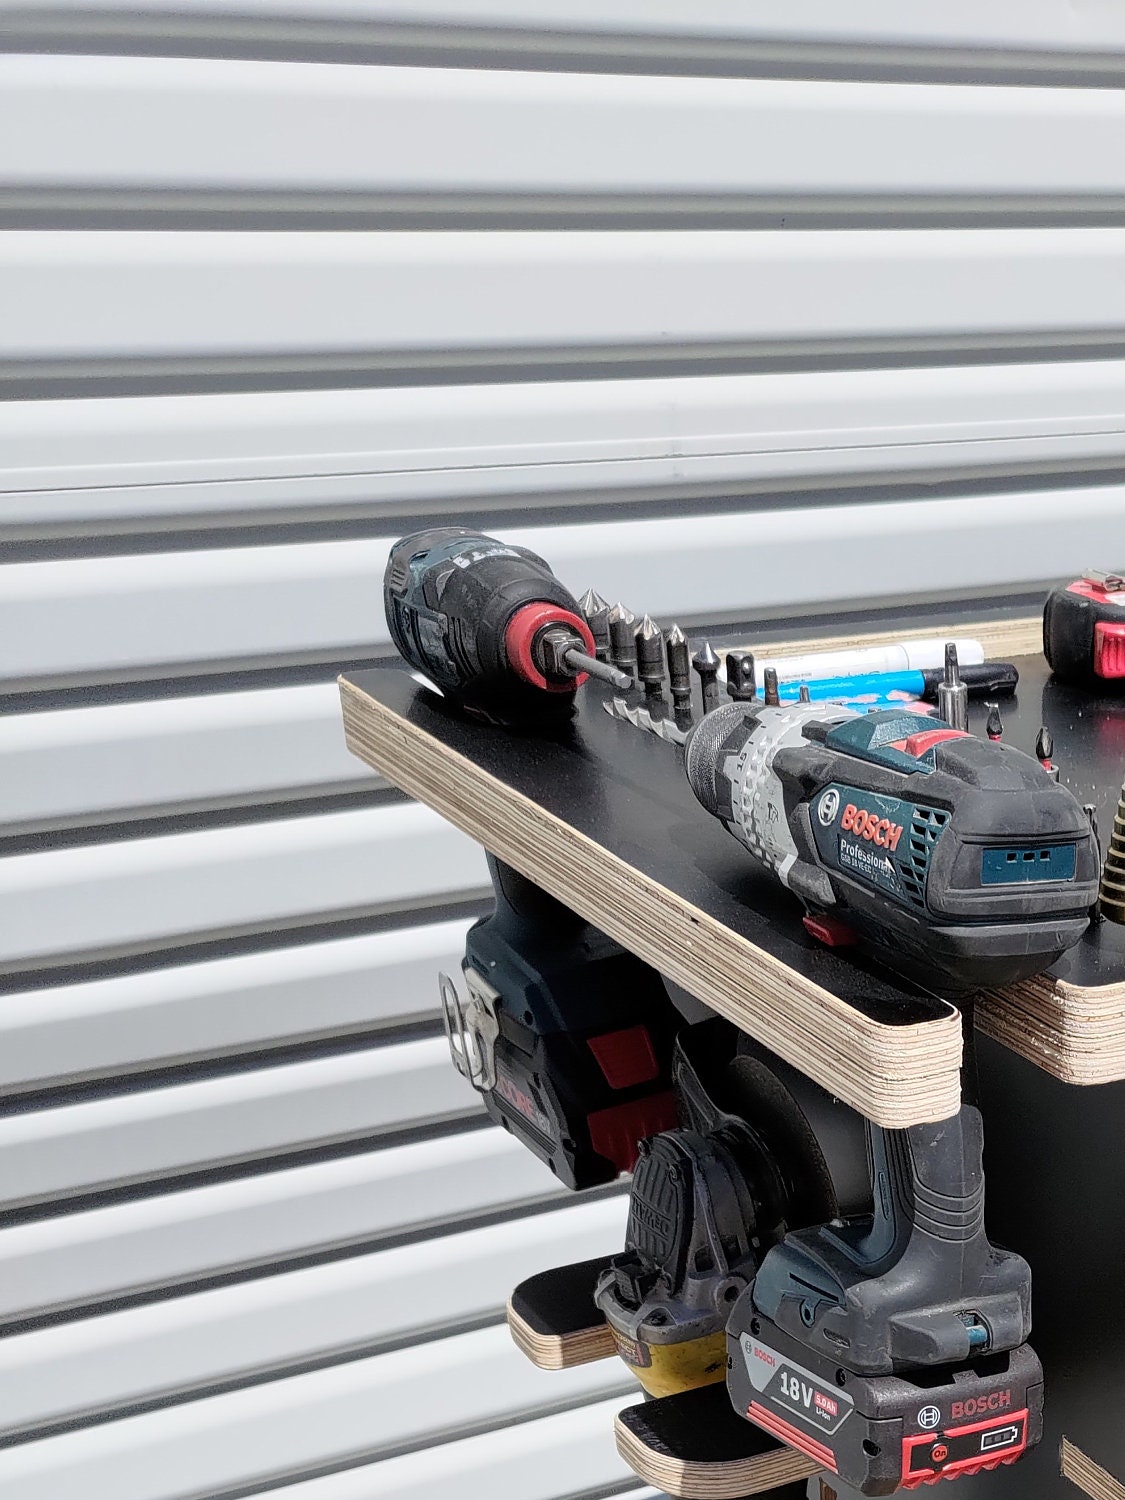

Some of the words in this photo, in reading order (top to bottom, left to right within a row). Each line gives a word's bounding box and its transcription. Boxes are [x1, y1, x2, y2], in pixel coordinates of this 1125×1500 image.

[840, 803, 904, 852] BOSCH
[753, 1346, 776, 1368] BOSCH
[779, 1370, 814, 1410] 18V
[814, 1393, 837, 1415] 5.0Ah
[950, 1388, 1012, 1420] BOSCH
